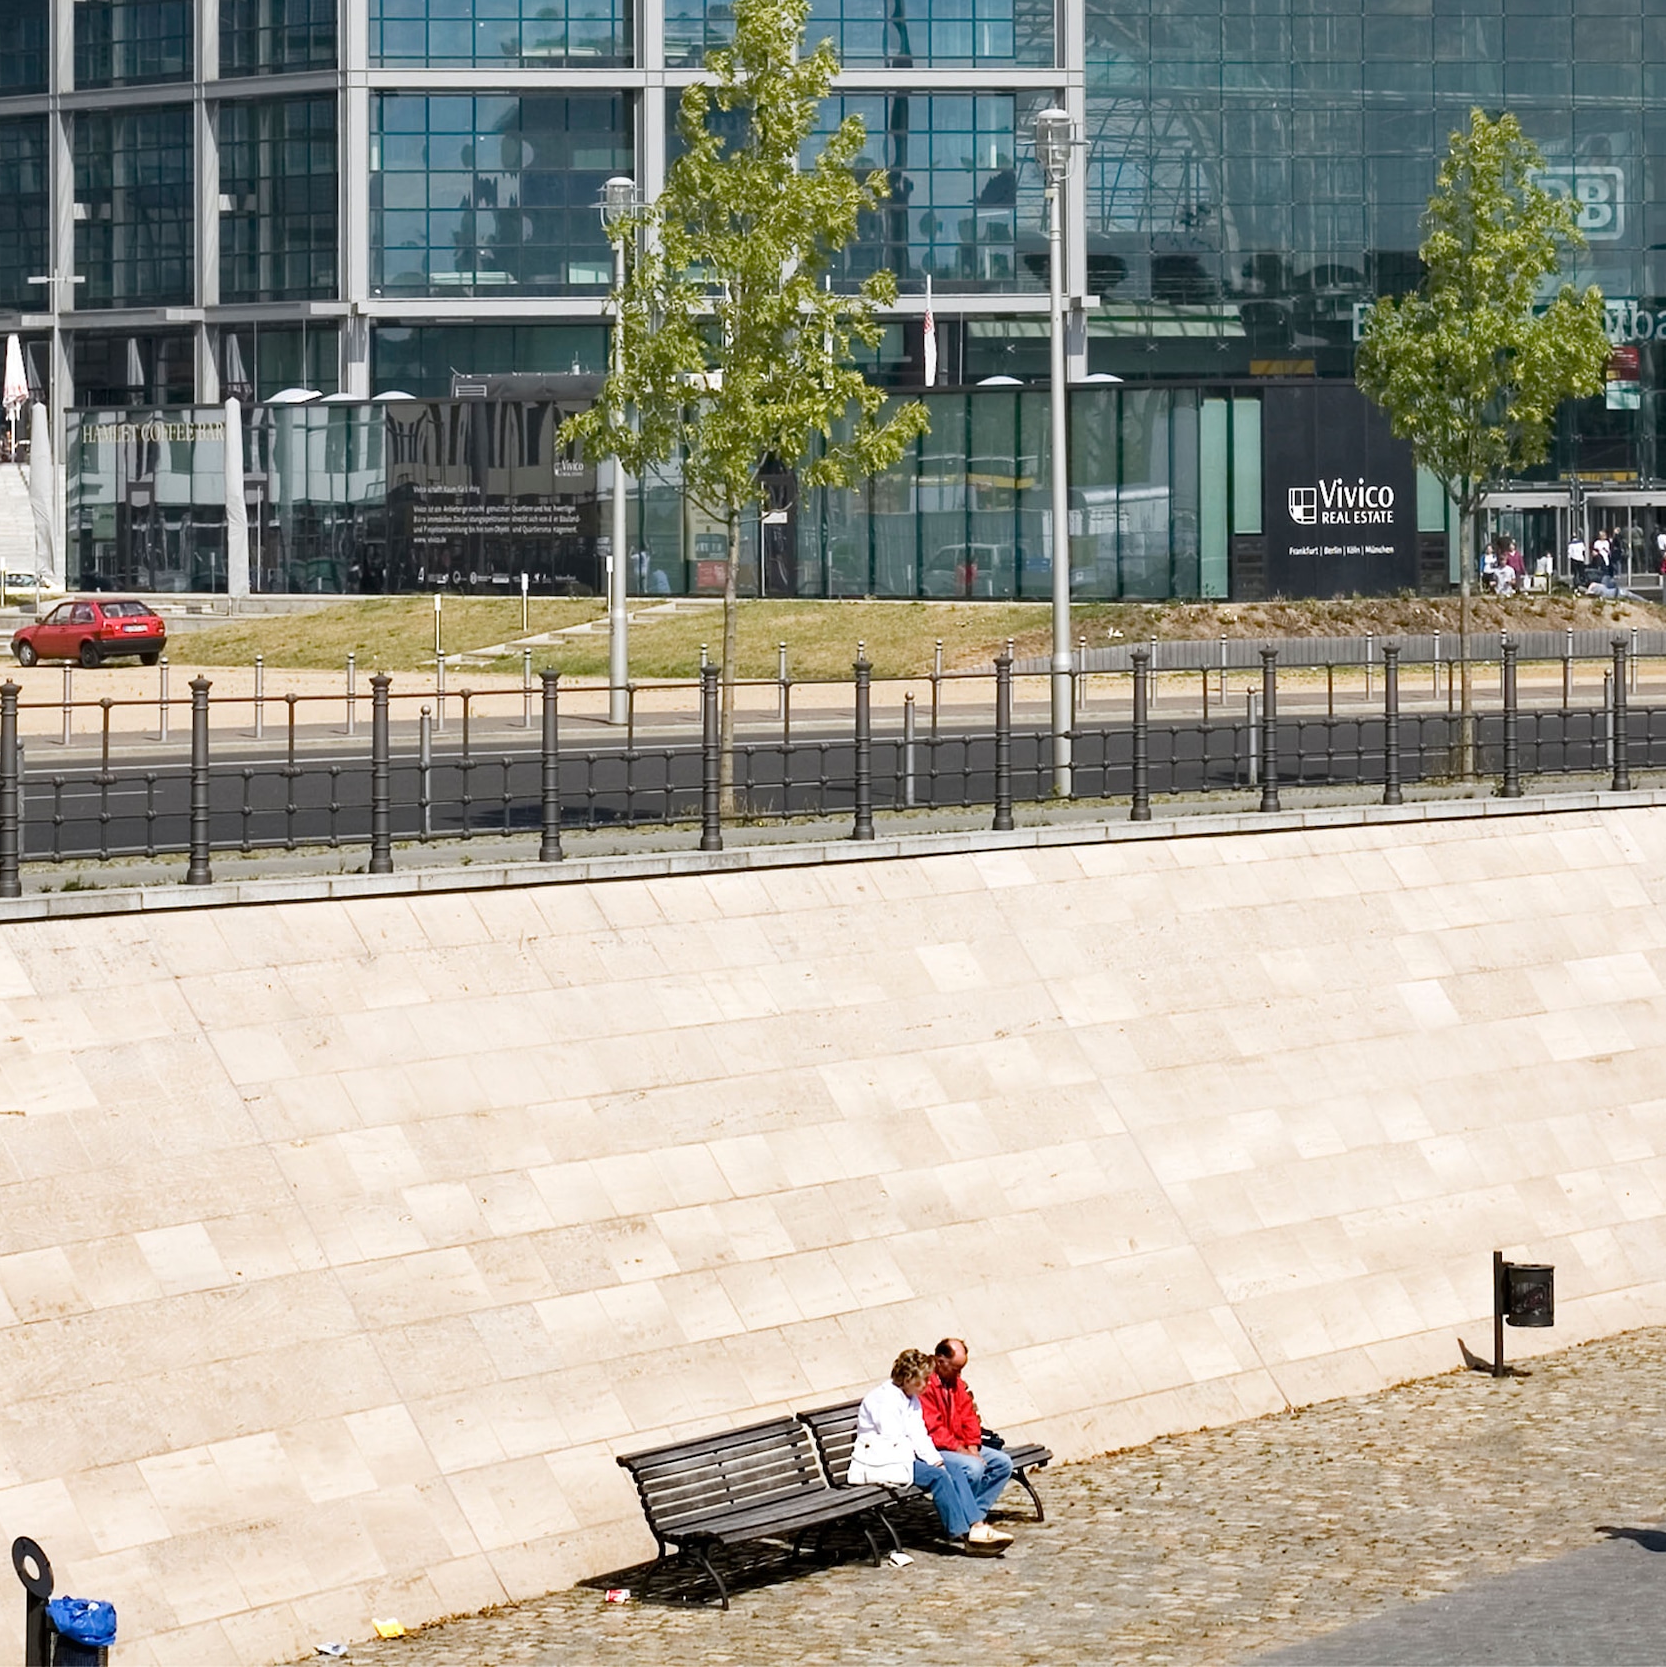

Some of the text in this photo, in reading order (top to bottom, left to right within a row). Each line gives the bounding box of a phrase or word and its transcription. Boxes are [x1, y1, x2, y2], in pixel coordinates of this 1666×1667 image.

[83, 421, 225, 443] HAMLET COFFEE BAR
[1319, 478, 1394, 508] Vivico
[1322, 510, 1394, 524] REAL ESTATE
[1289, 544, 1394, 555] Frankfurt Berlin Köln München
